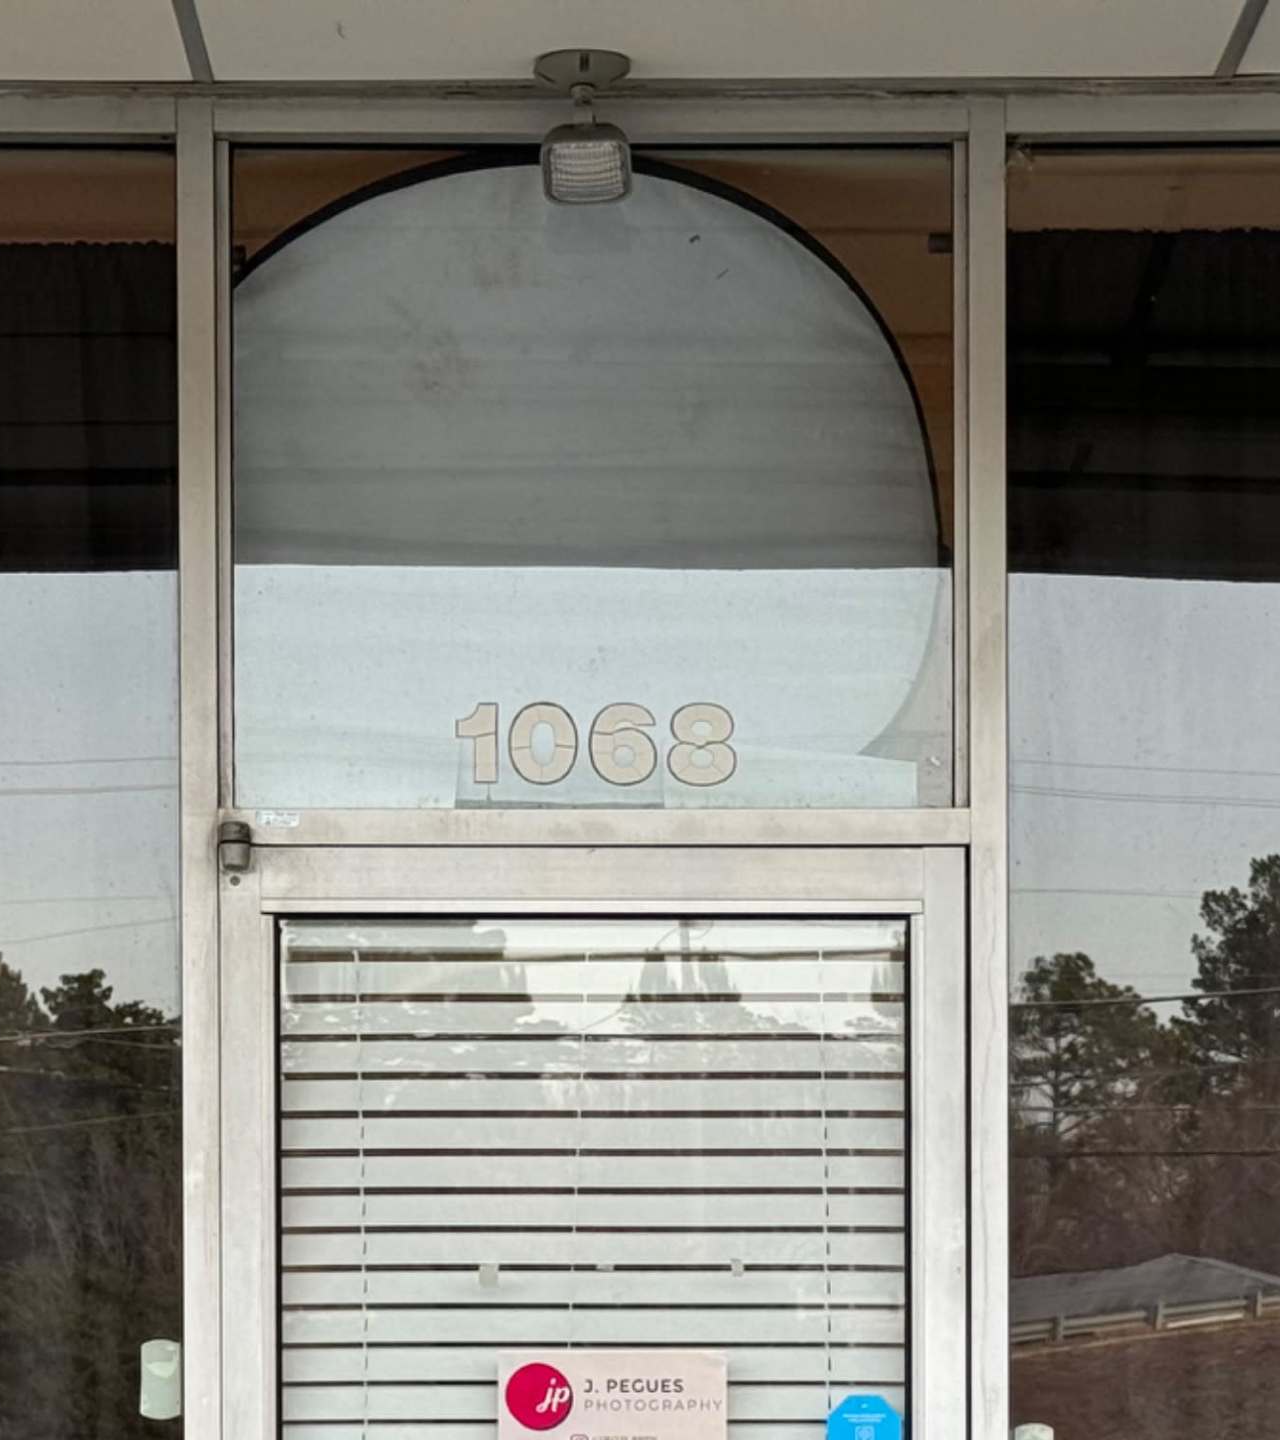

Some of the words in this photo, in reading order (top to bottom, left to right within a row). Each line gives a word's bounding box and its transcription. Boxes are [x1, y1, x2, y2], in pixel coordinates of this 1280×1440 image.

[455, 700, 737, 787] 1068
[535, 1376, 570, 1413] jp
[583, 1379, 600, 1394] J.
[606, 1379, 684, 1394] PEGUES
[583, 1399, 723, 1412] PHOTOGRAPHY
